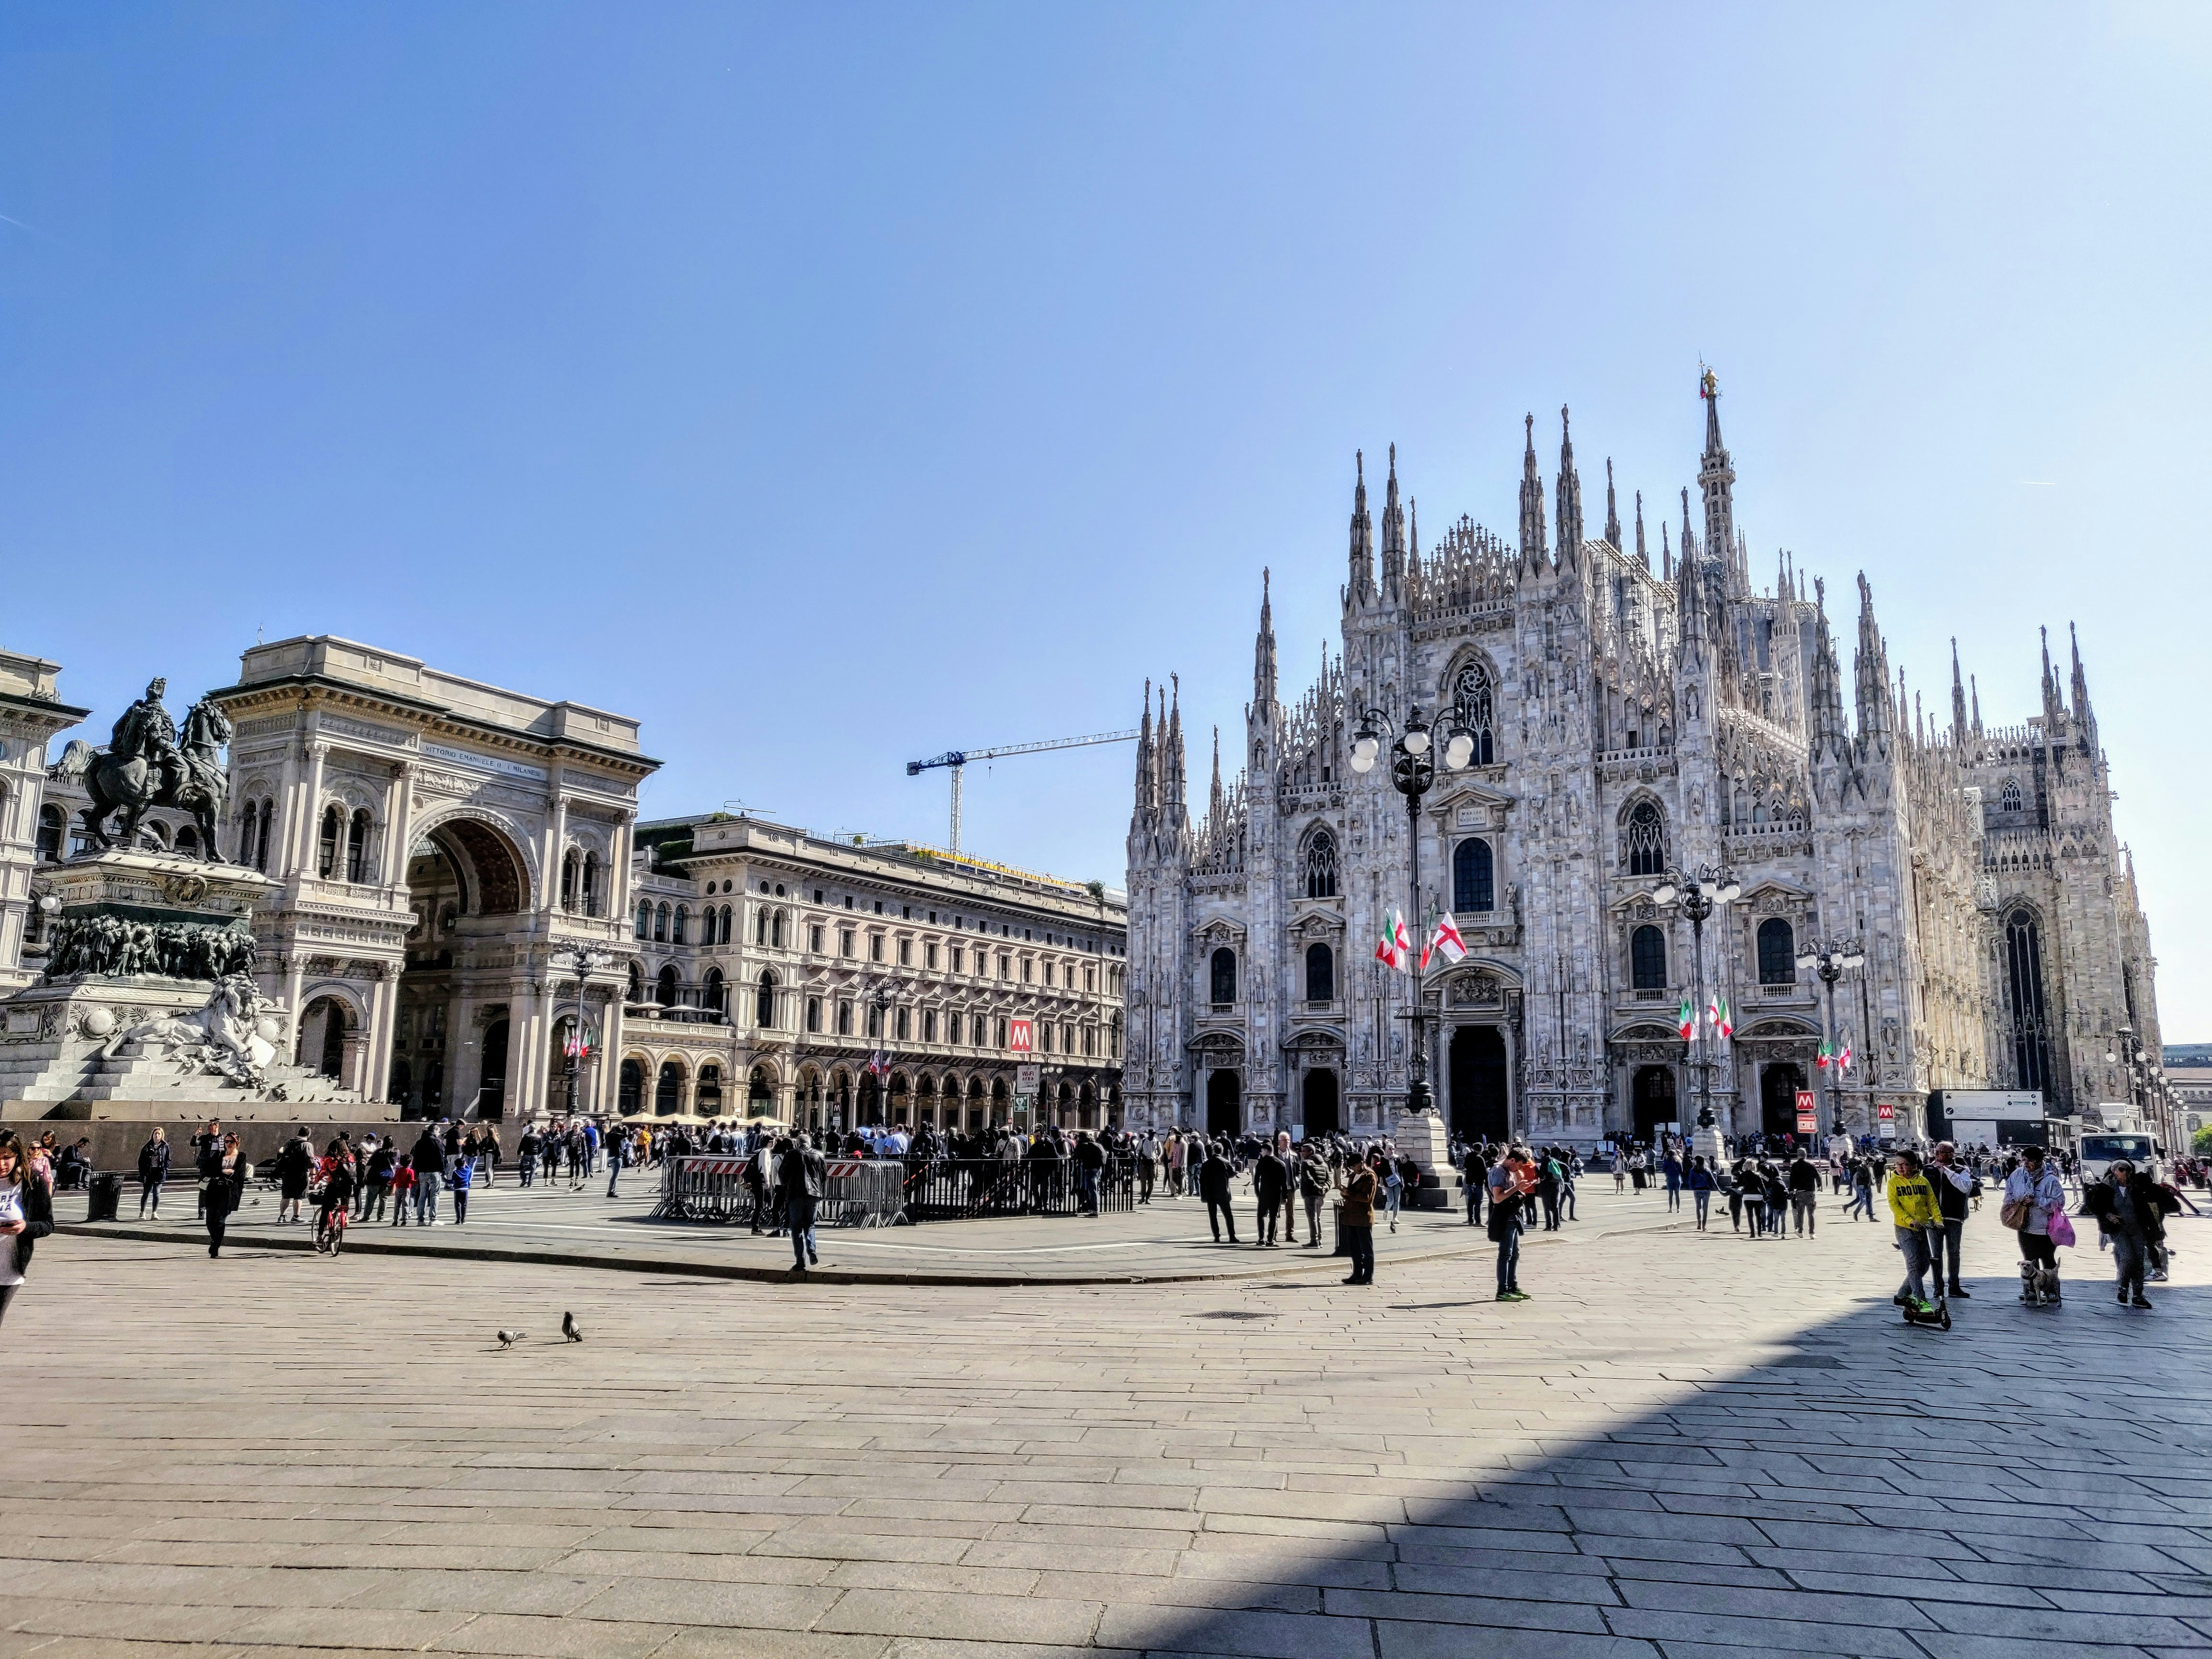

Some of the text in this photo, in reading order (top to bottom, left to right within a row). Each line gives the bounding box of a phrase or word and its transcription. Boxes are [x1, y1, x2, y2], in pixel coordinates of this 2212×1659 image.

[425, 745, 456, 757] VITTORIO
[459, 753, 494, 767] EMANUELE
[1012, 1025, 1029, 1046] M
[1798, 1095, 1813, 1106] M
[1879, 1107, 1892, 1117] M
